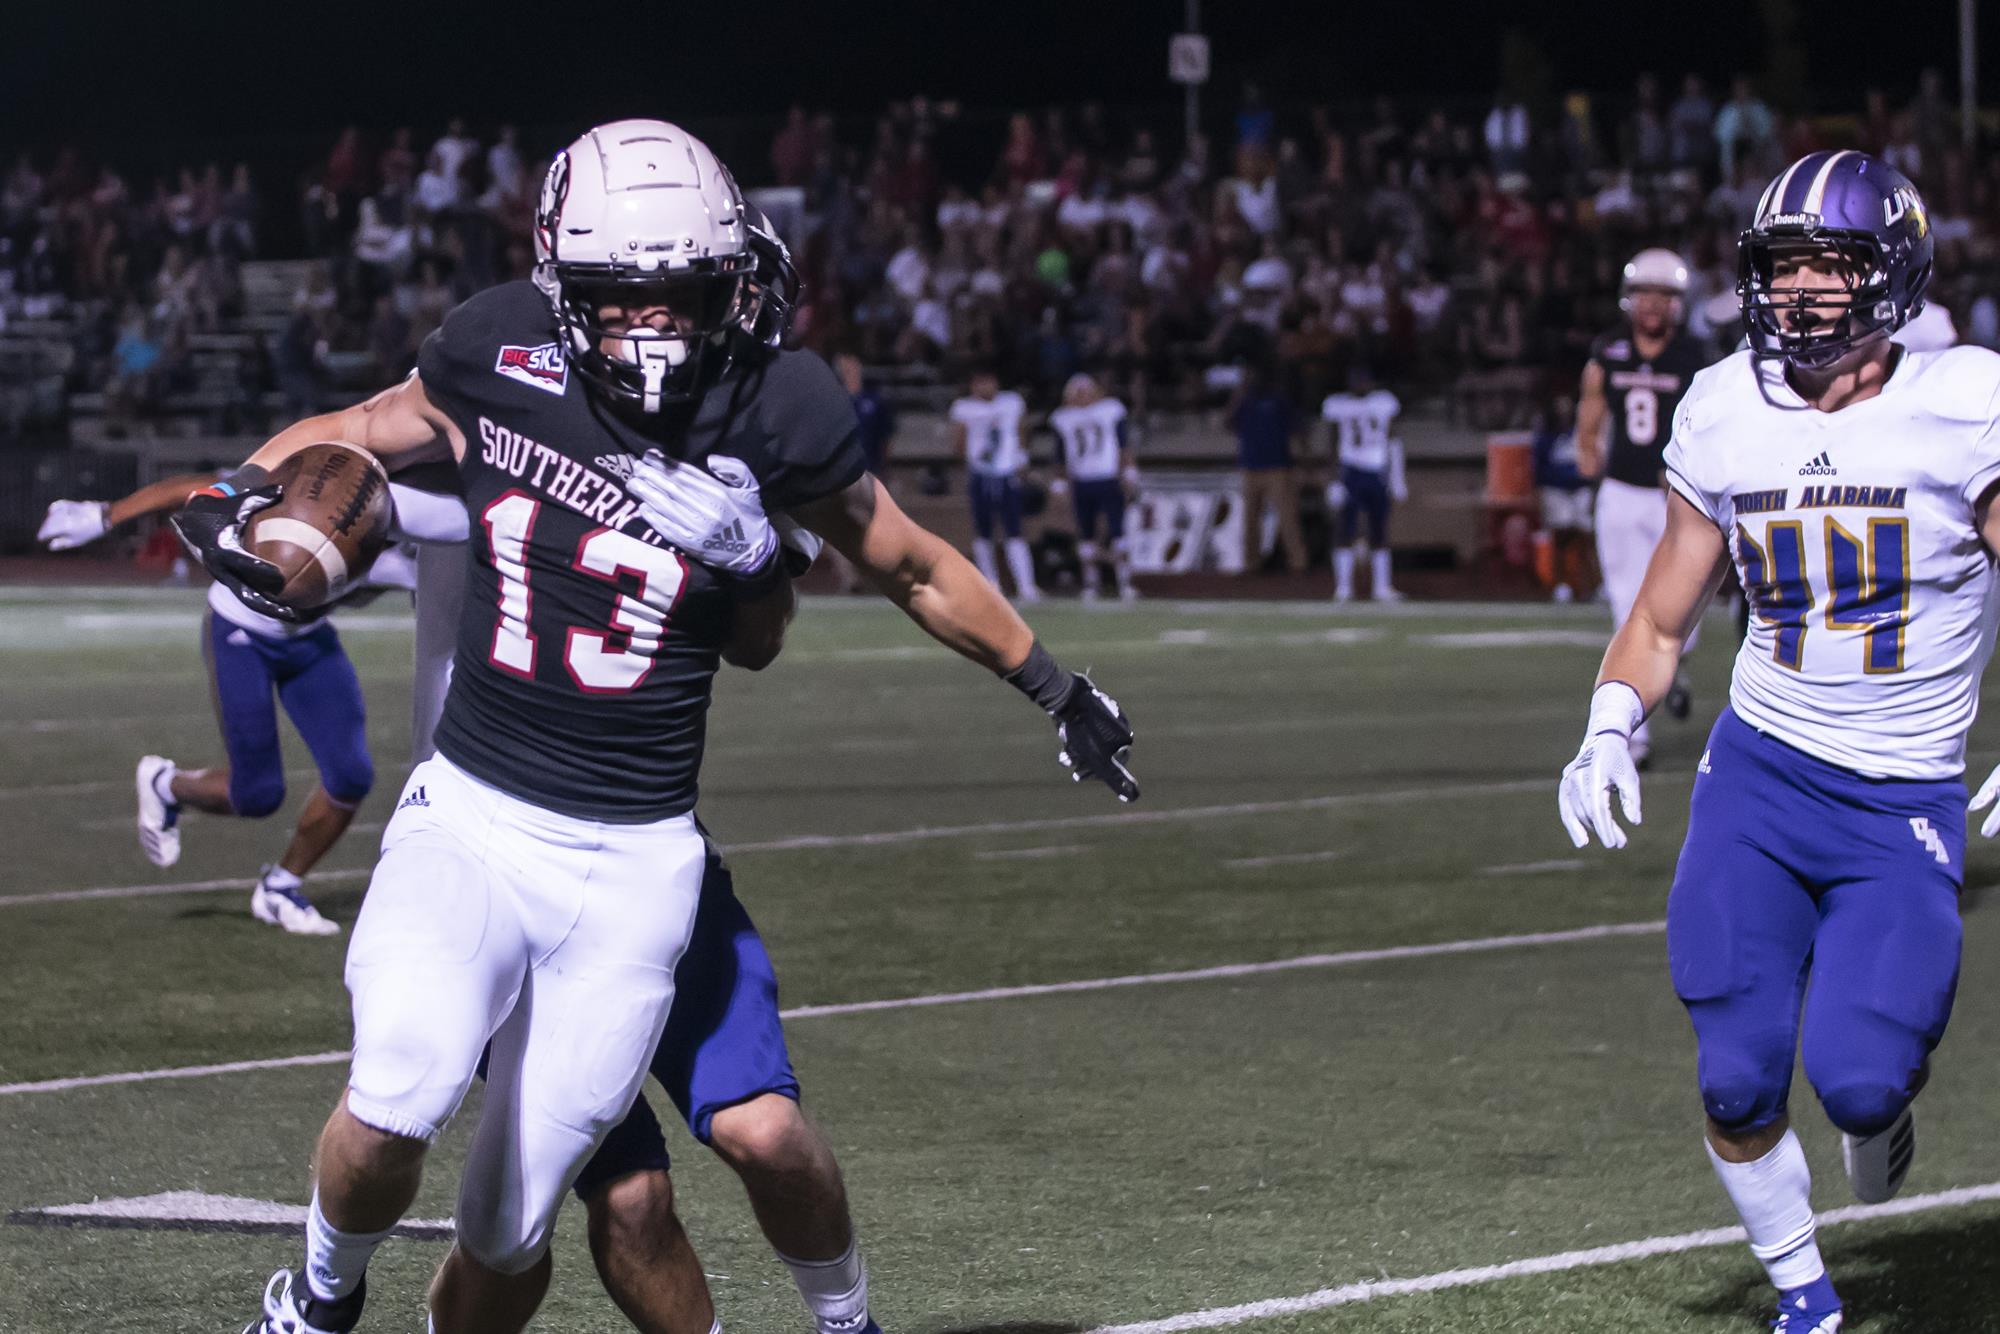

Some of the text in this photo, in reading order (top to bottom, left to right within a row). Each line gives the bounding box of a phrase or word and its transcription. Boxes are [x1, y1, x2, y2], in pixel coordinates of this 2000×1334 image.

[1623, 386, 1659, 445] 8
[1795, 485, 1907, 509] ALABAMA
[1798, 465, 1838, 476] adidas
[479, 487, 690, 694] 13
[1735, 514, 1911, 675] 44
